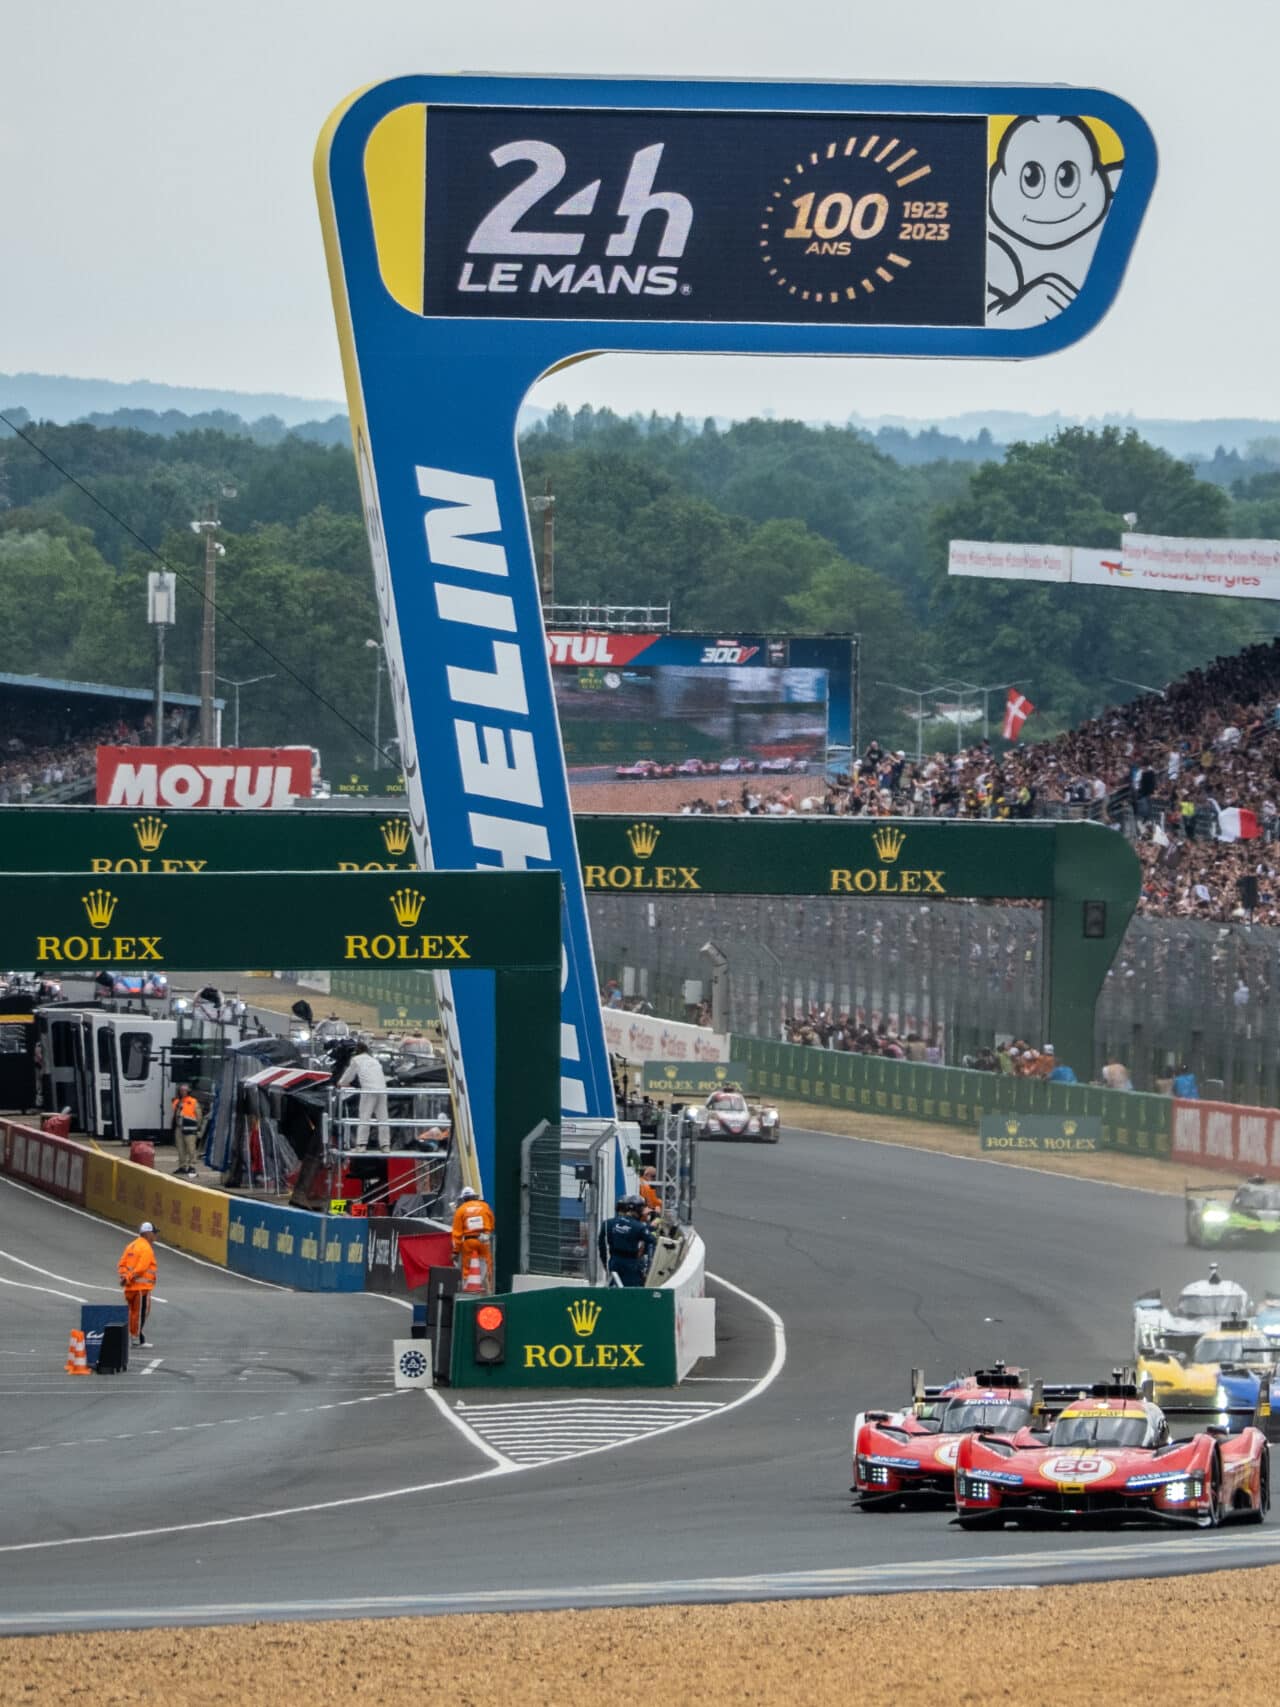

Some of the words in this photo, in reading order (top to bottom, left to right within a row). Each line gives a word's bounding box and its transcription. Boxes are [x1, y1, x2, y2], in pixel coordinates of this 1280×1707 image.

[783, 191, 890, 240] 100
[902, 201, 950, 220] 1923
[898, 221, 951, 242] 2023
[805, 241, 852, 257] ANS
[457, 262, 520, 293] LE
[529, 263, 679, 296] MANS
[110, 763, 301, 807] MOTUL
[584, 866, 701, 891] ROLEX
[830, 869, 946, 895] ROLEX
[37, 936, 164, 961] ROLEX
[344, 934, 471, 960] ROLEX
[987, 1136, 1039, 1148] ROLEX
[1043, 1137, 1096, 1150] ROLEX
[524, 1343, 646, 1369] ROLEX
[1055, 1459, 1100, 1473] 50
